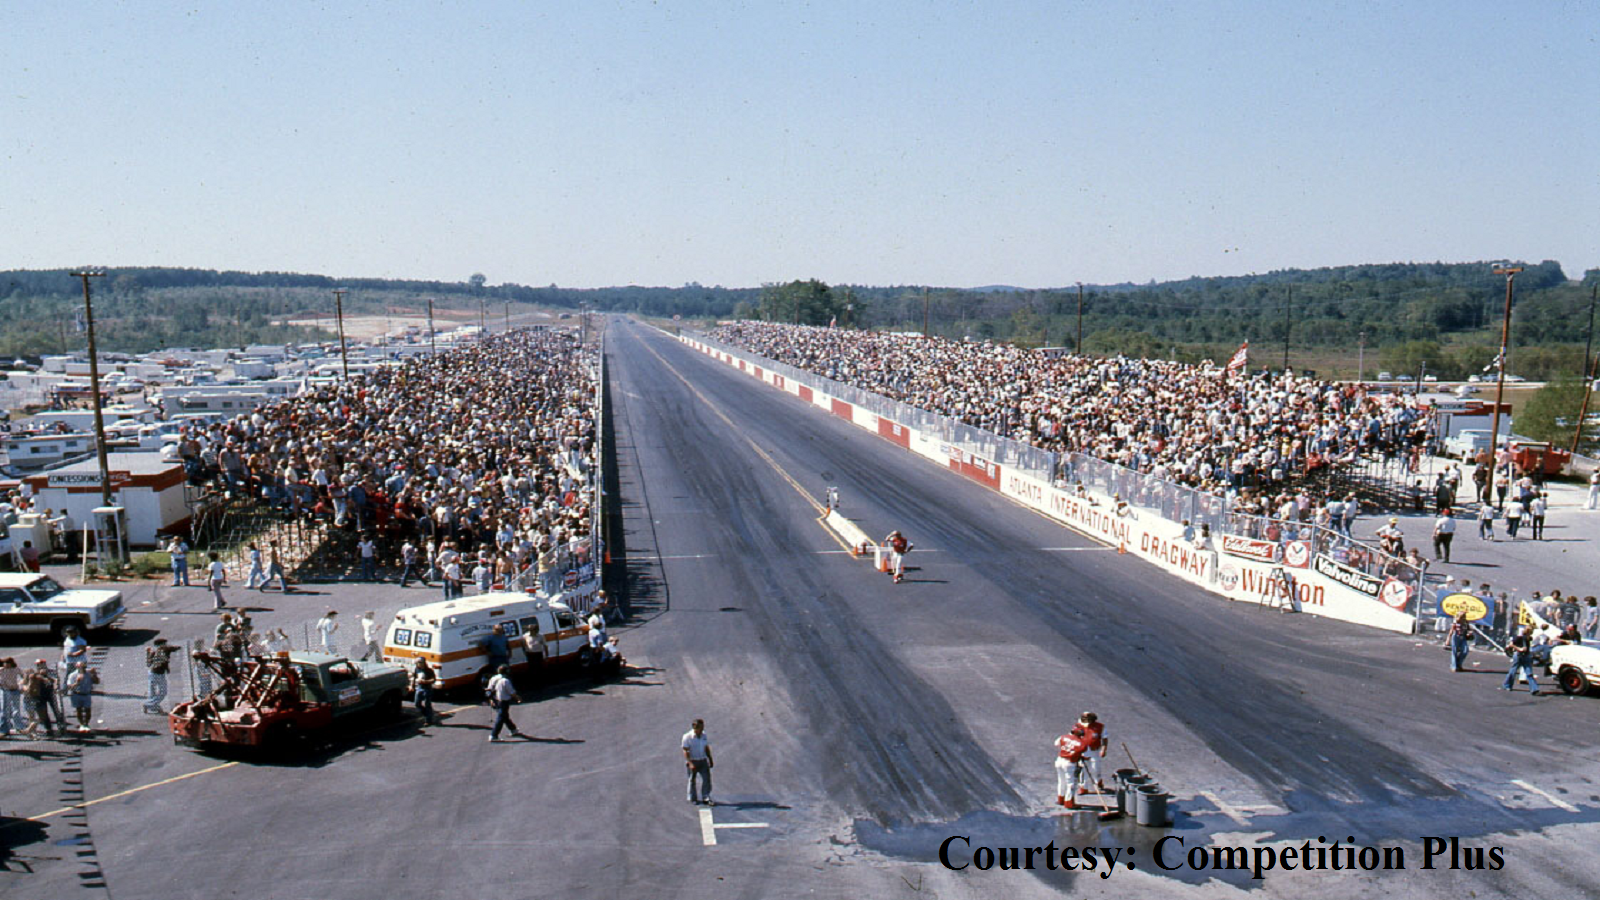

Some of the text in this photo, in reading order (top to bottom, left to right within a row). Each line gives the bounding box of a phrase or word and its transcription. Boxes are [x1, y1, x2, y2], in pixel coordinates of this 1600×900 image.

[1009, 475, 1209, 577] ATLANTA INTERNATIONAL DRAGWAY
[1241, 568, 1325, 607] Winston
[1318, 557, 1379, 595] Valvoline
